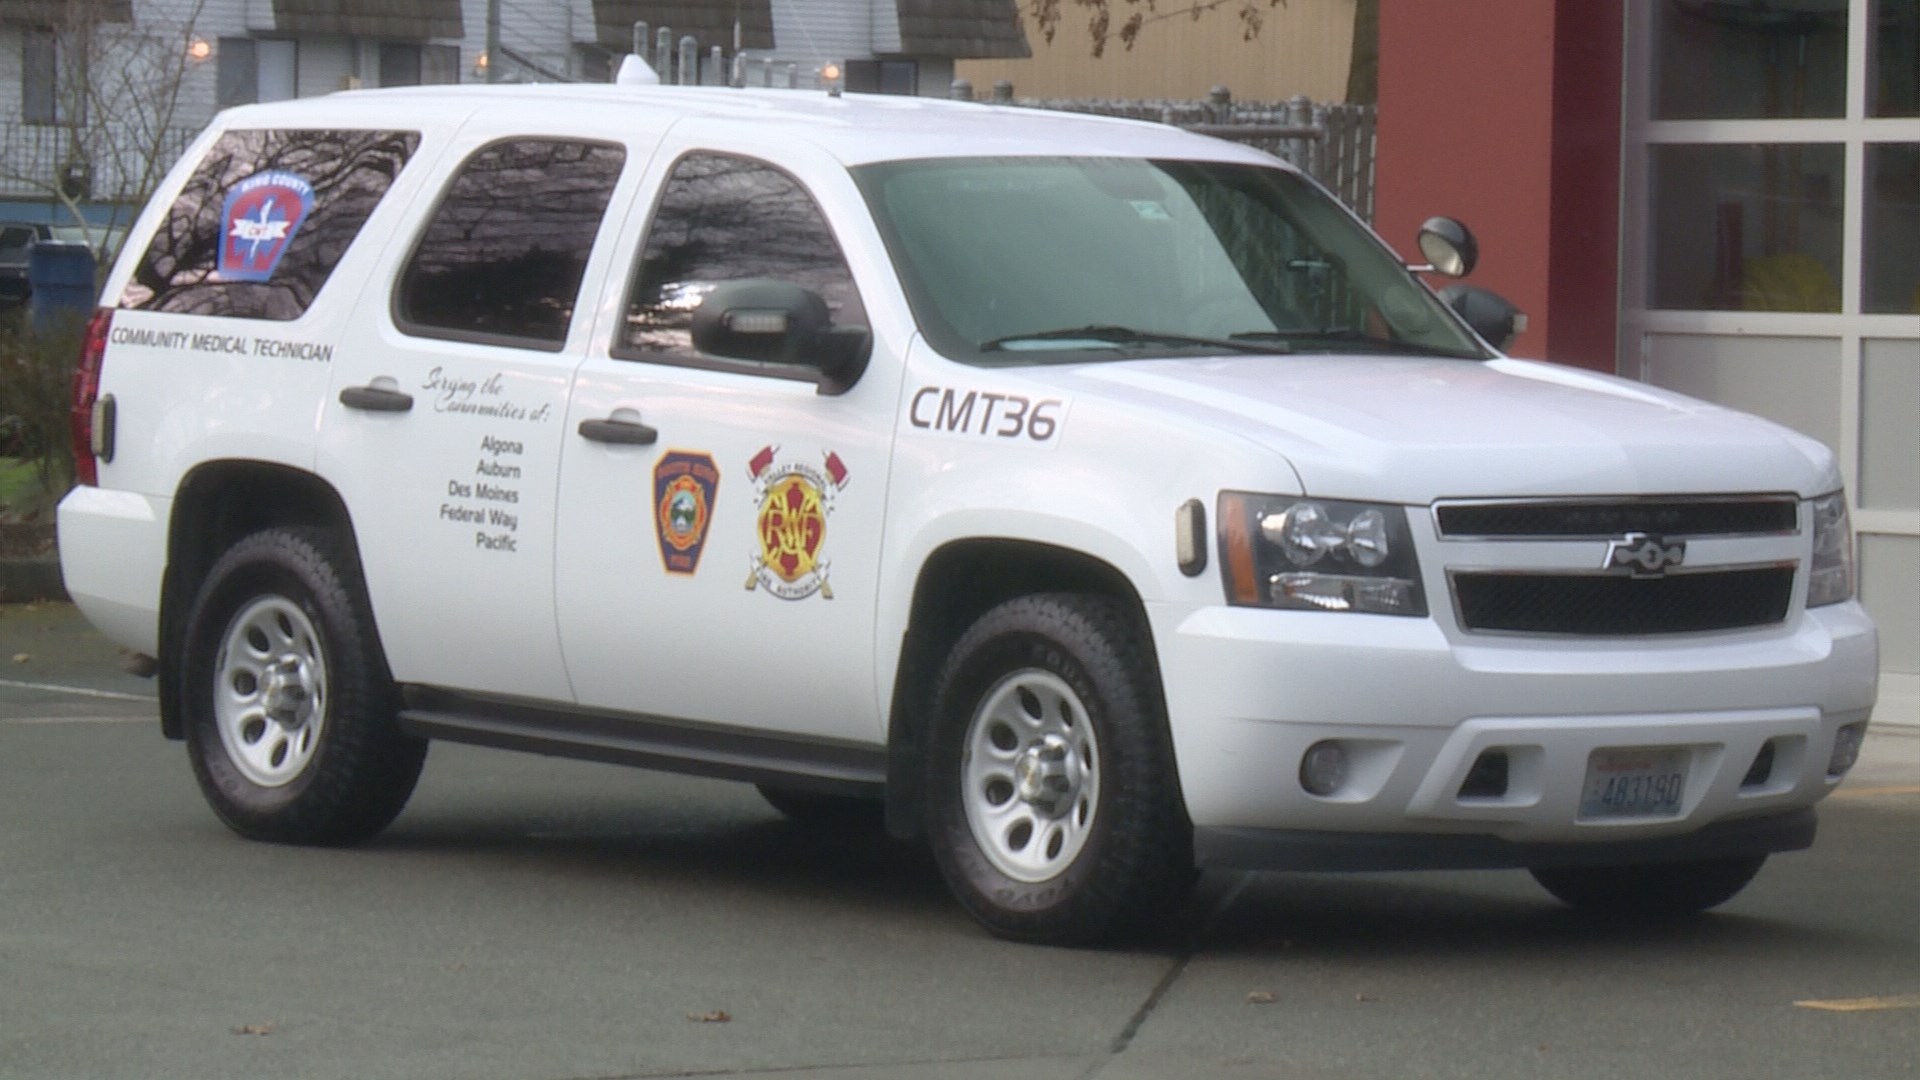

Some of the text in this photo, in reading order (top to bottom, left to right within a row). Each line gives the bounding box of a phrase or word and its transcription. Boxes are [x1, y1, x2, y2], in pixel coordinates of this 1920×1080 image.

[271, 173, 311, 195] COUNTY
[111, 327, 334, 361] COMMUNITY MEDICAL TECHNICIAN
[422, 366, 503, 400] Serving the
[434, 400, 525, 420] Communities
[909, 386, 1062, 441] CMT36
[481, 435, 523, 456] Algona
[476, 459, 521, 478] Auburn
[448, 479, 519, 503] Des Moines
[440, 503, 518, 531] Federal Way
[476, 531, 517, 552] Pacific
